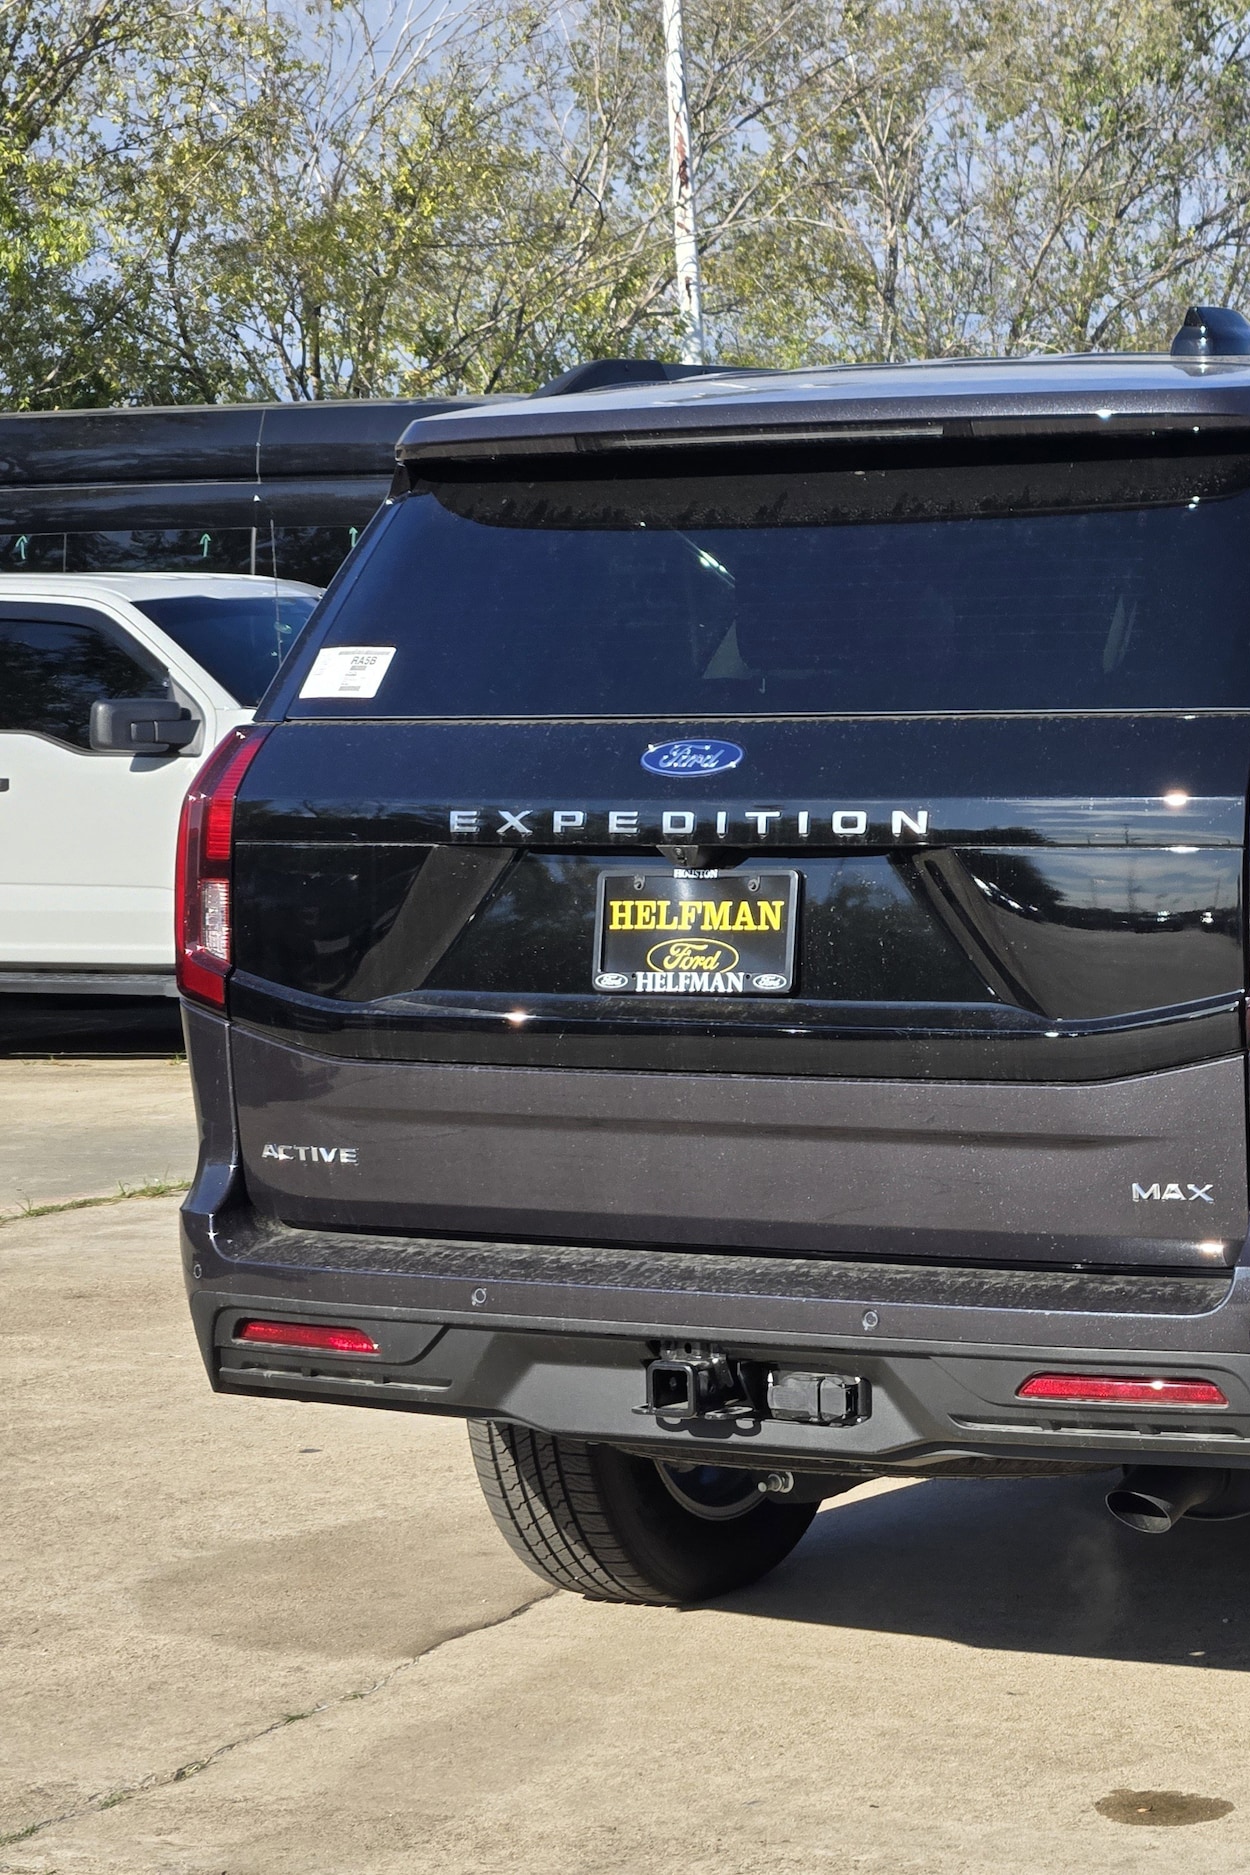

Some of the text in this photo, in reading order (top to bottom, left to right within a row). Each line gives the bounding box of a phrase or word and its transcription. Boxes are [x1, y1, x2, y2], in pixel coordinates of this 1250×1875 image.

[659, 744, 725, 768] Ford
[449, 810, 929, 835] EXPEDITION
[673, 868, 718, 879] HOUSTON
[608, 900, 785, 931] HELFMAN
[662, 942, 722, 971] Ford
[635, 971, 745, 993] HELFMAN
[261, 1143, 360, 1163] ACTIVE
[1131, 1183, 1215, 1202] MAX
